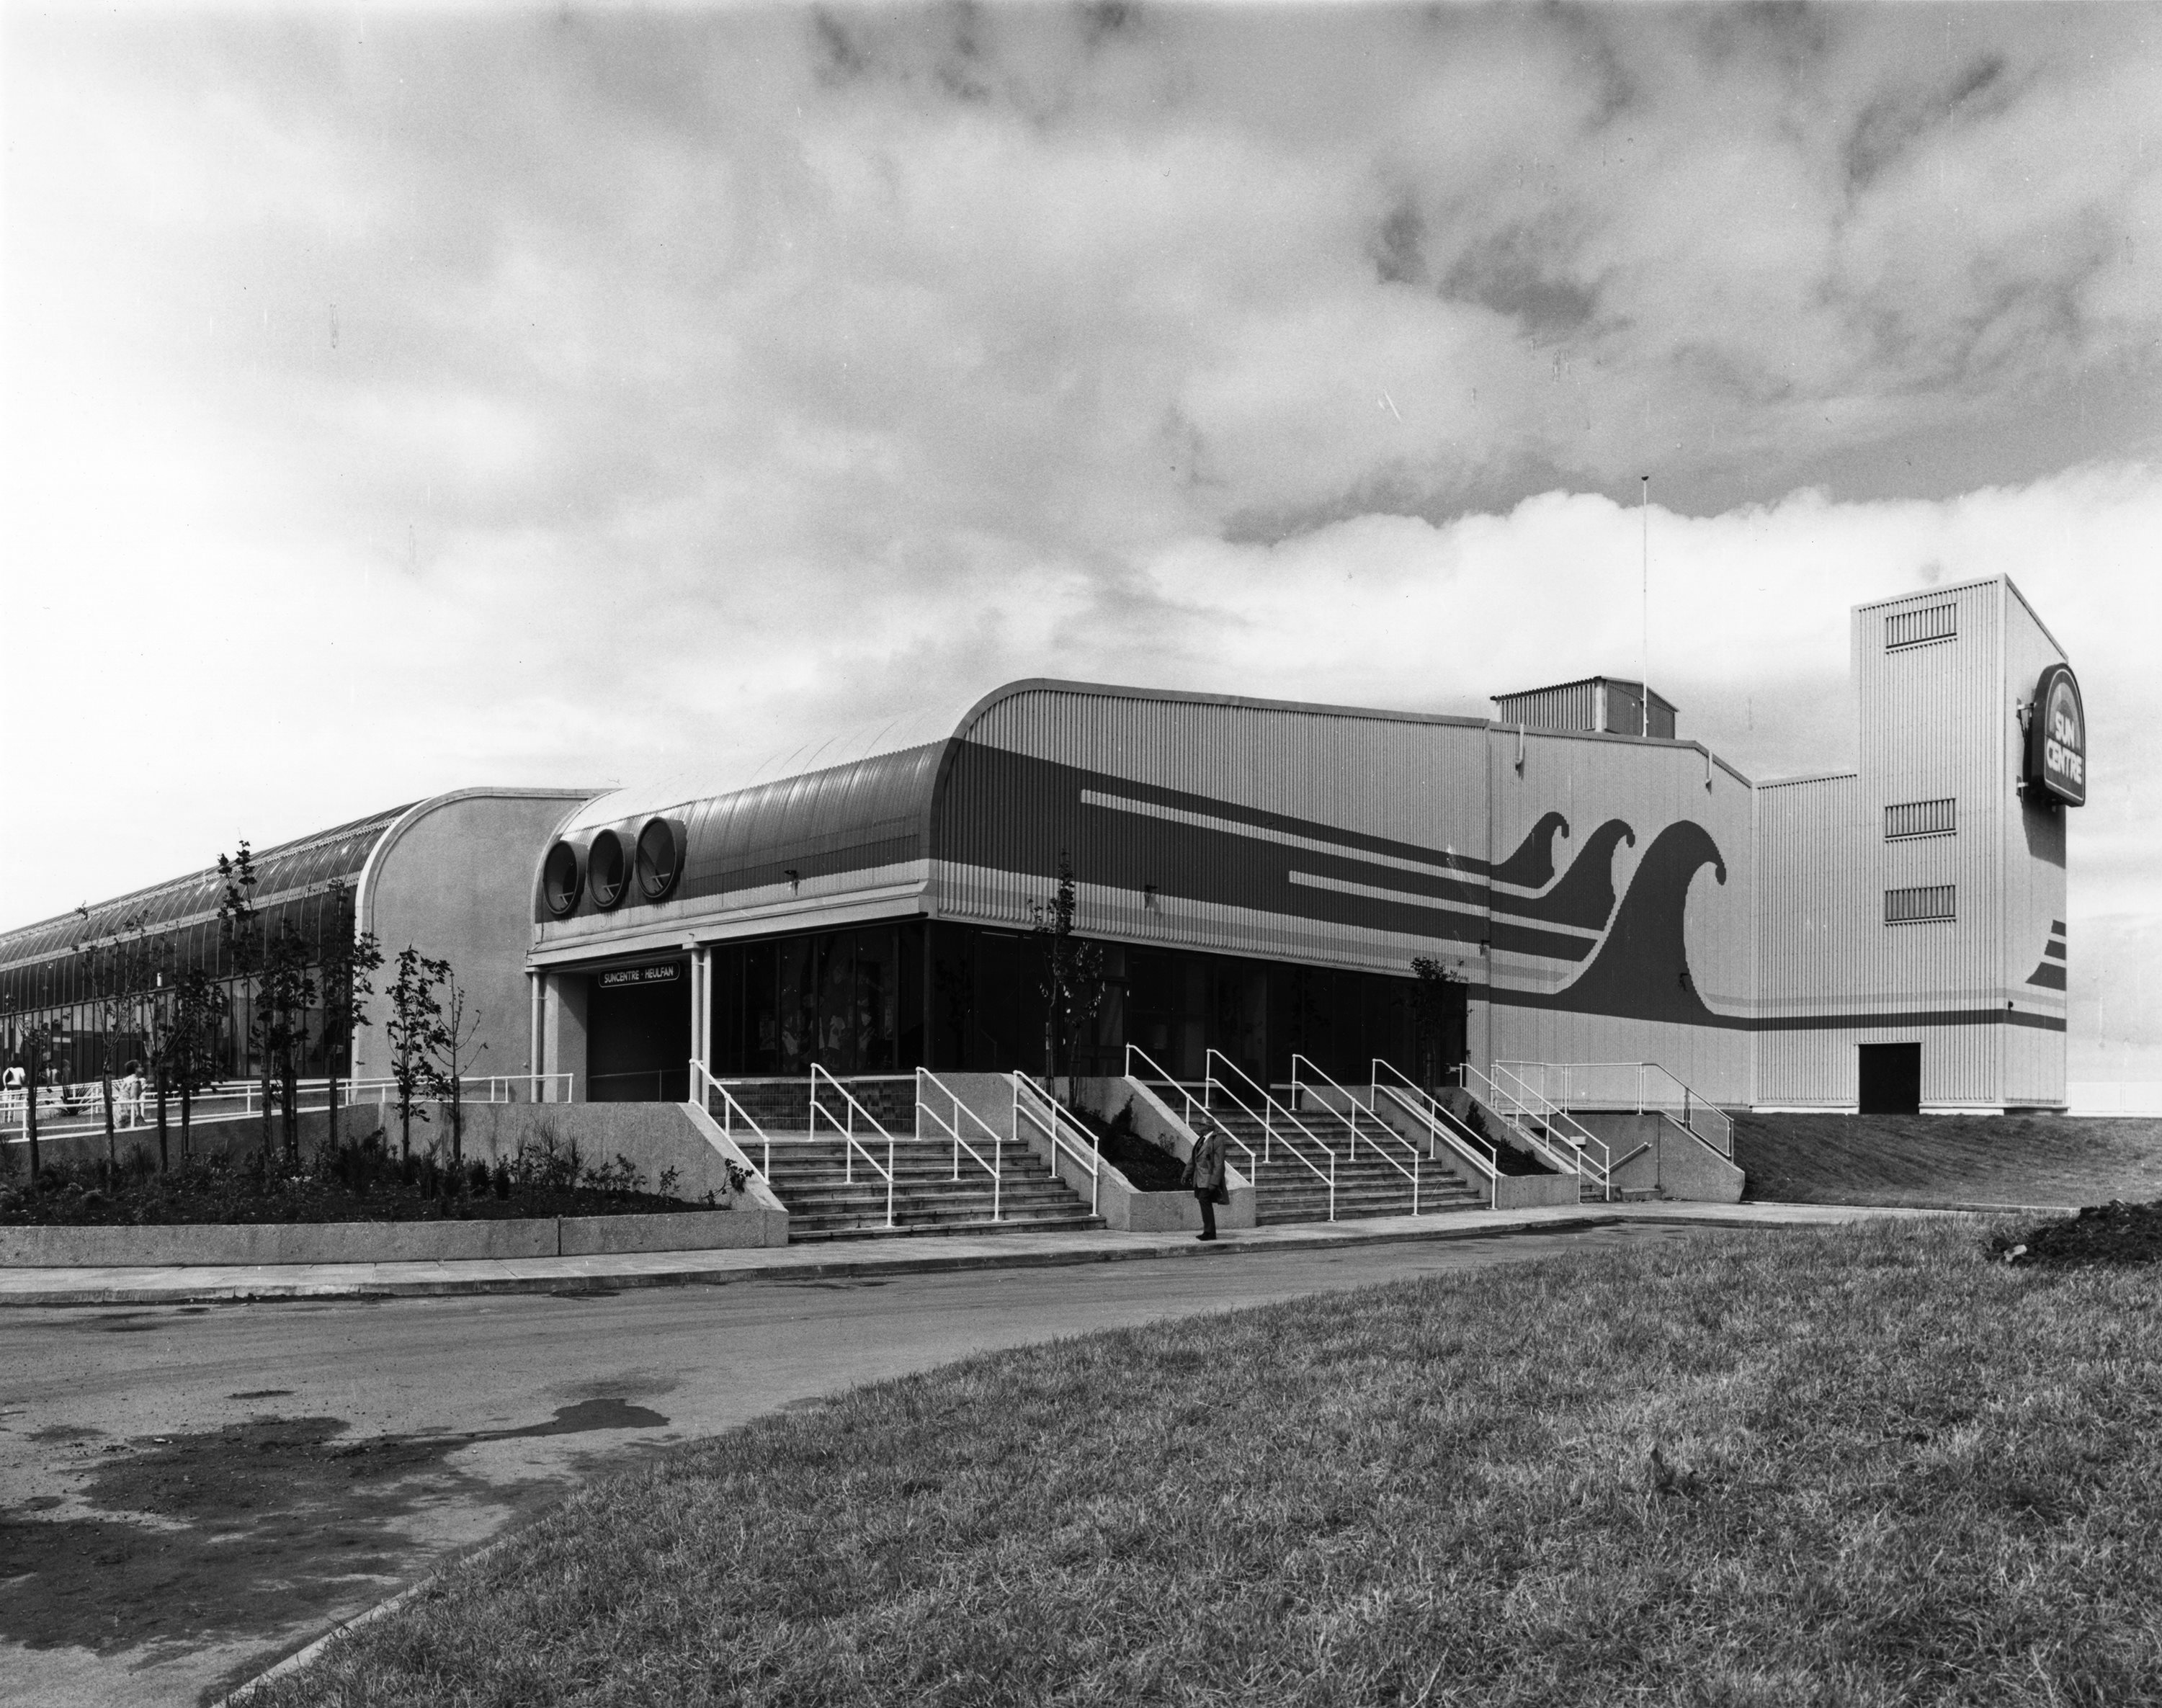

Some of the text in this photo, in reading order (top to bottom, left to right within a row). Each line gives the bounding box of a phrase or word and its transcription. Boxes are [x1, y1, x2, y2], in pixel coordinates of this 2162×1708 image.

[2055, 711, 2075, 749] SUN
[2047, 738, 2082, 784] CENTRE
[604, 966, 674, 983] SUNCENTRE HEULFAN
